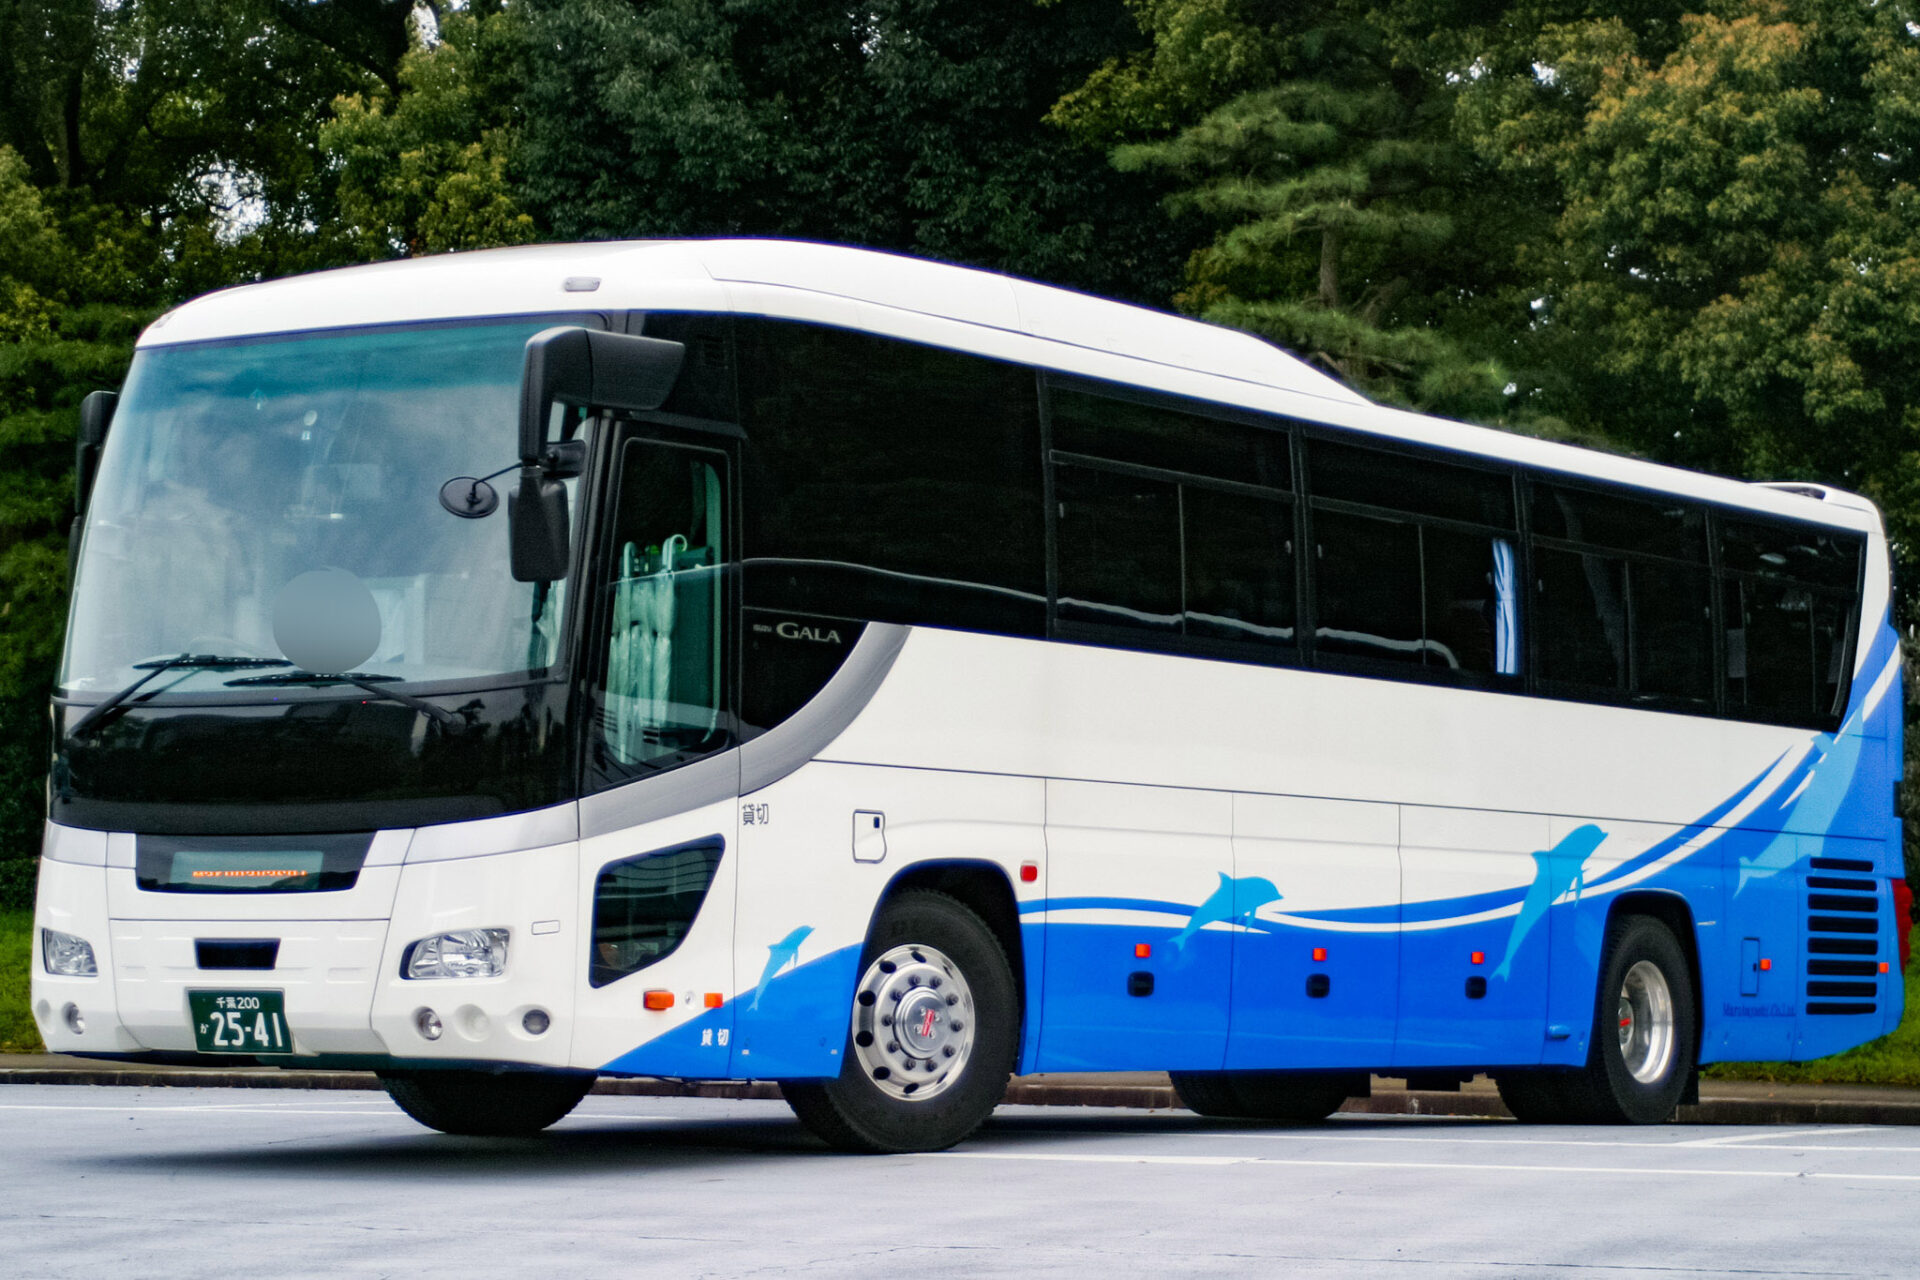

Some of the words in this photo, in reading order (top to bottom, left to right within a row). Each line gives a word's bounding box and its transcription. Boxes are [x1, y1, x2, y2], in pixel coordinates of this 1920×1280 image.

[776, 622, 841, 643] GALA
[742, 803, 769, 826] 貸切
[210, 1011, 283, 1047] 25-41
